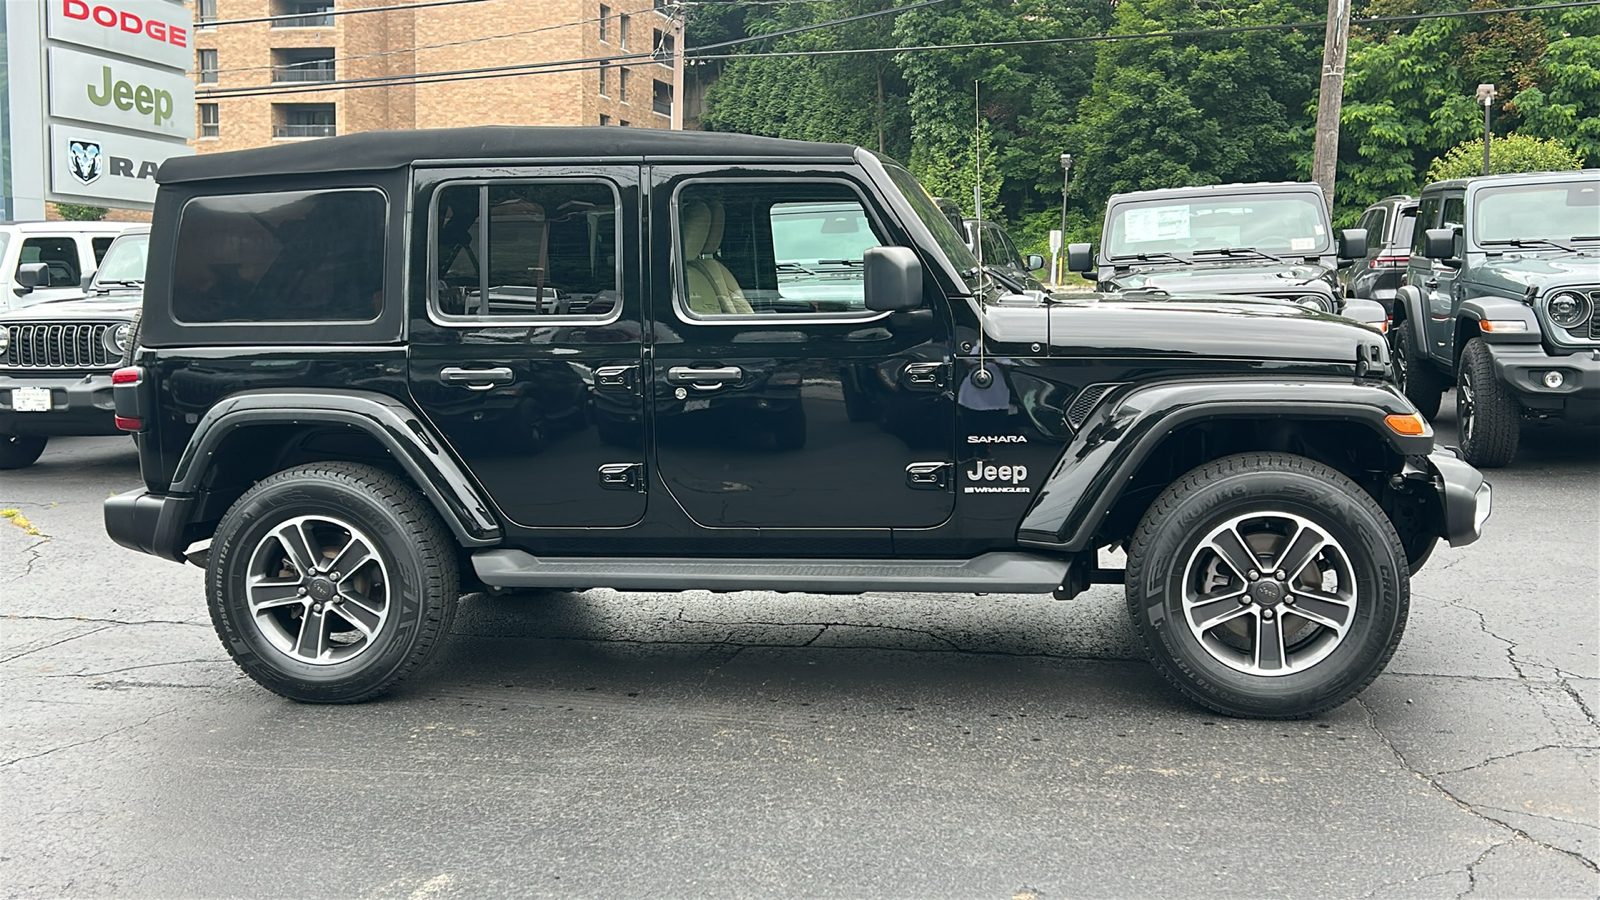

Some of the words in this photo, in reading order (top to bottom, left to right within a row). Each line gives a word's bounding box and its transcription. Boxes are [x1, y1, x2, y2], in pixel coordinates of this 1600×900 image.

[63, 0, 187, 48] DODGE
[87, 66, 173, 126] Jeep
[109, 156, 158, 181] RA
[967, 435, 1028, 443] SAHARA
[967, 461, 1028, 484] Jeep
